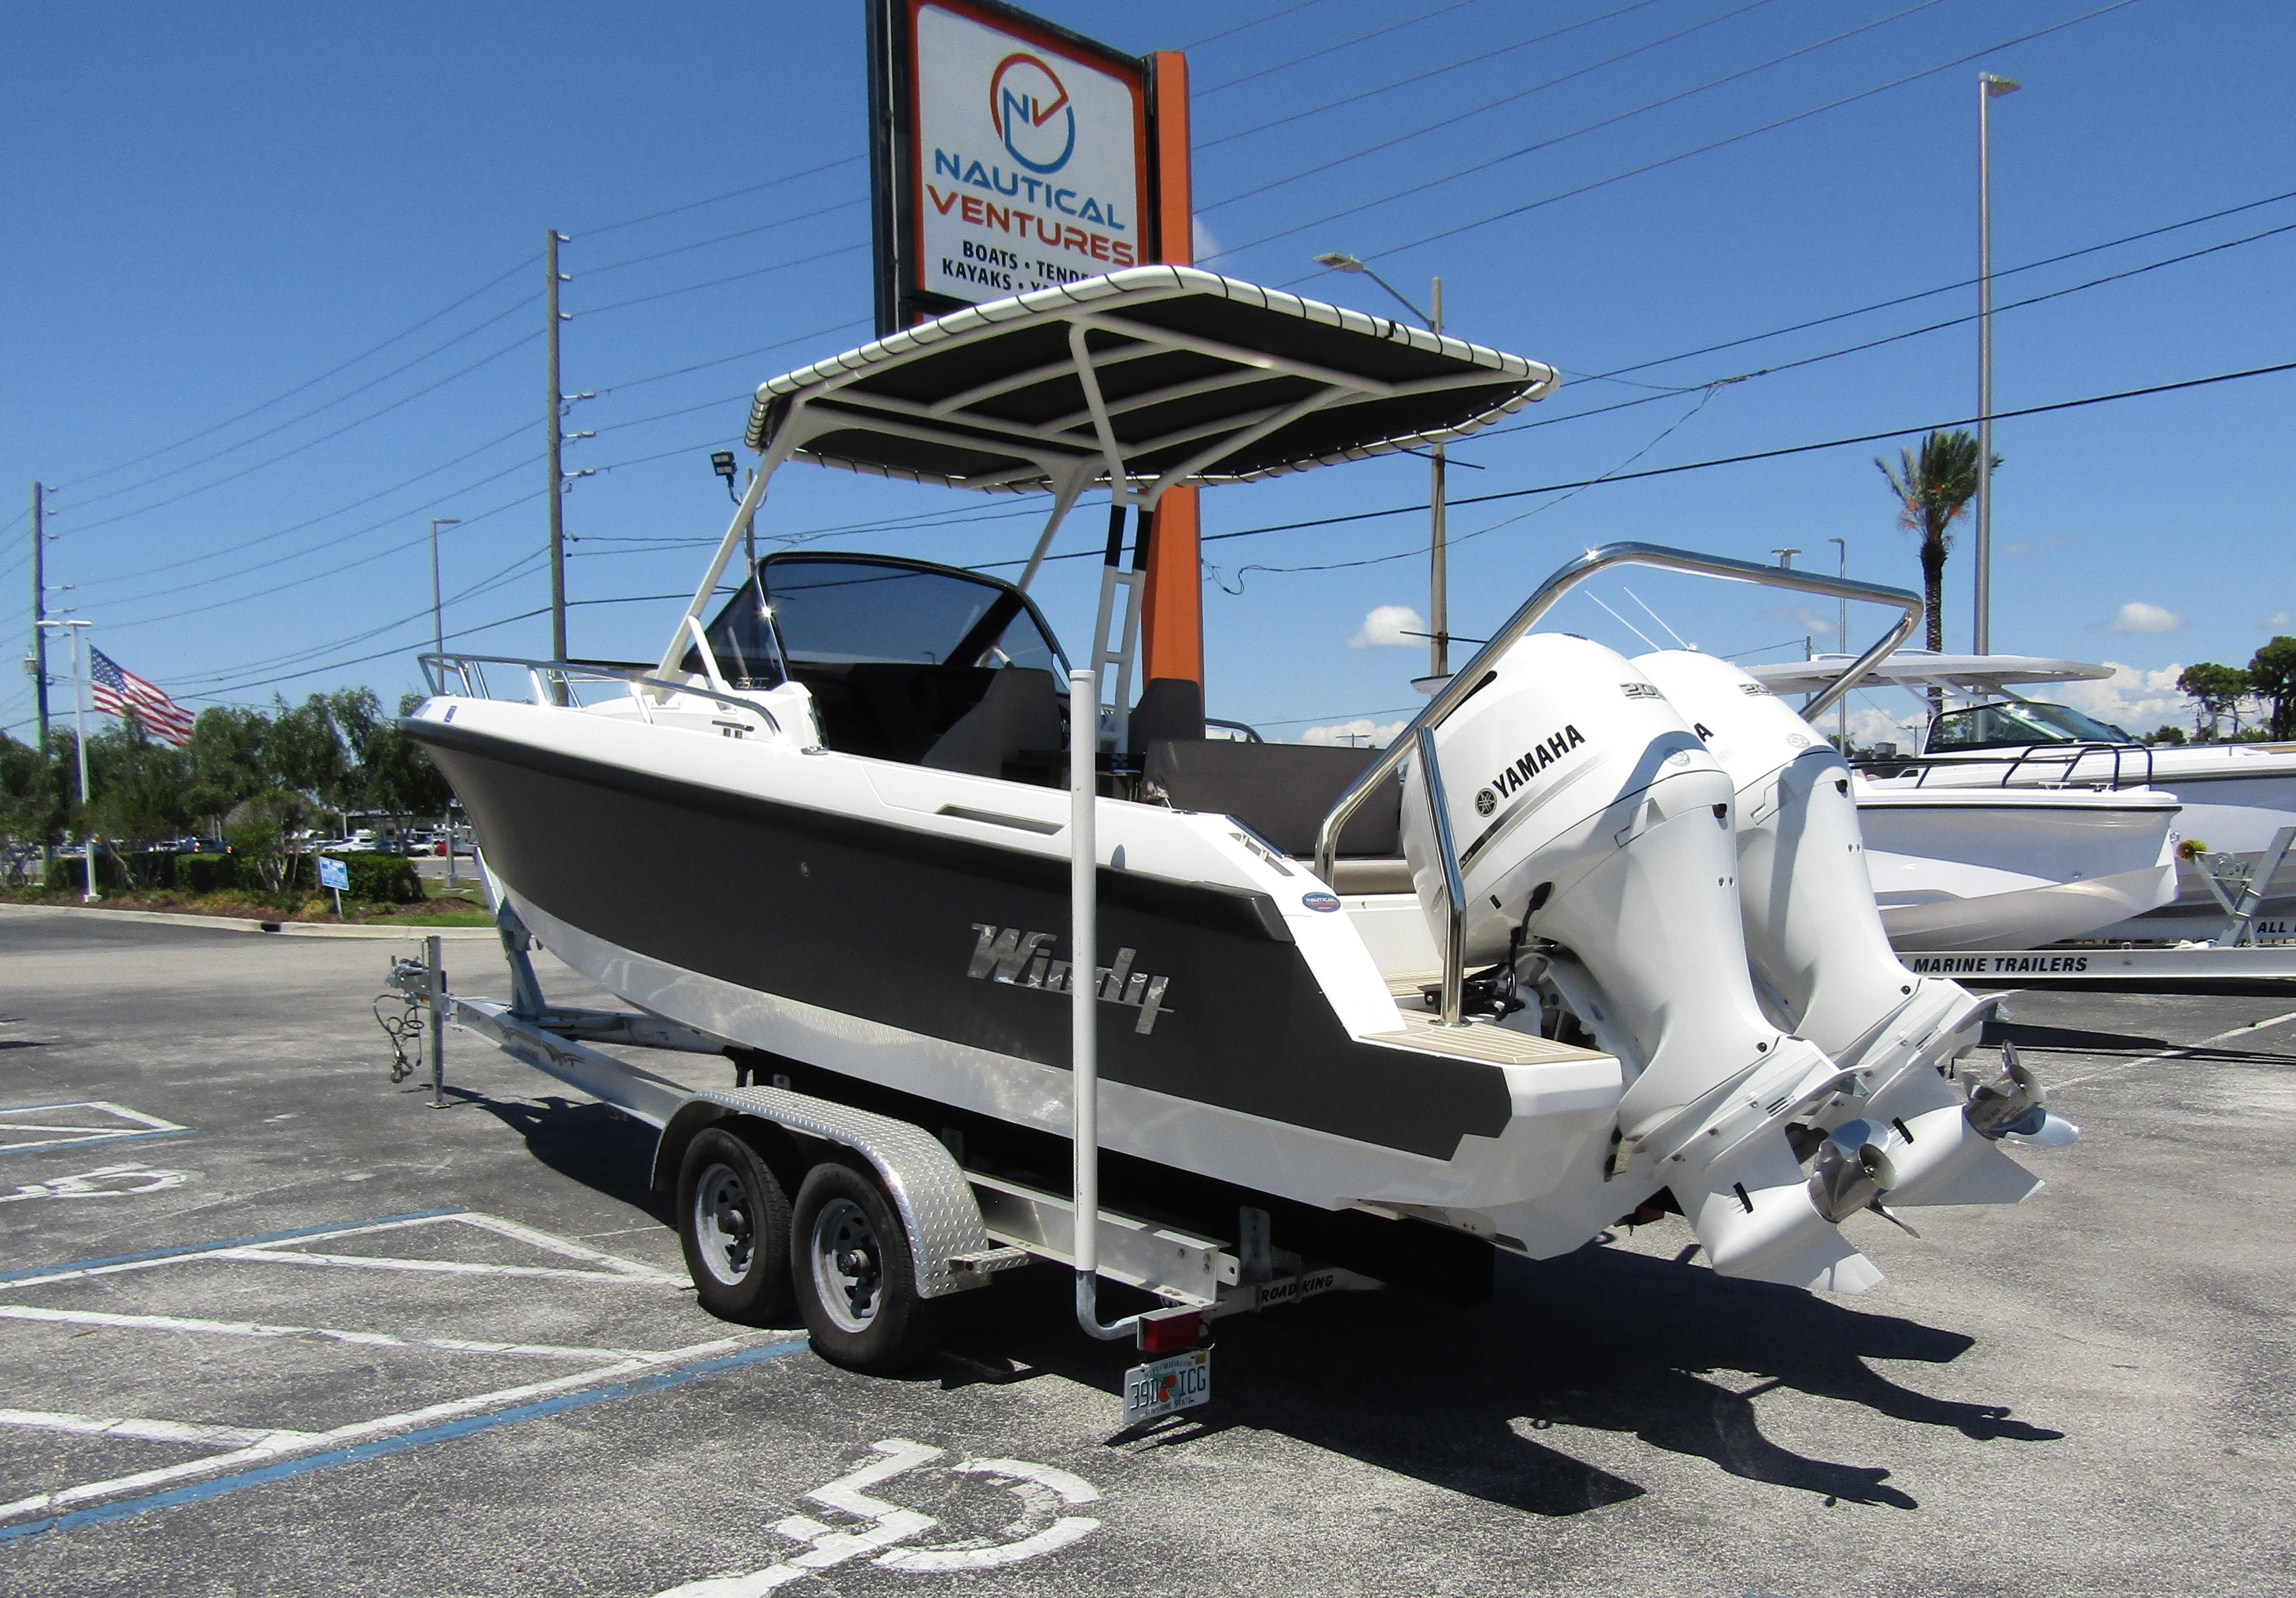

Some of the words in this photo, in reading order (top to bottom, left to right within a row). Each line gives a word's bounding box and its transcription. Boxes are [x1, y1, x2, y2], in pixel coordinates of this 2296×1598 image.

[935, 148, 1125, 230] NAUTICAL
[925, 183, 1135, 267] VENTURES
[942, 257, 1011, 291] KAYAKS
[963, 240, 1018, 270] BOATS
[1036, 260, 1094, 283] TEND
[1492, 724, 1585, 799] YAMAHA
[2257, 921, 2287, 933] ALL
[1913, 958, 1987, 972] MARINE
[1995, 957, 2087, 972] TRAILERS
[1262, 1283, 1297, 1302] ROAD
[1302, 1274, 1333, 1293] KING
